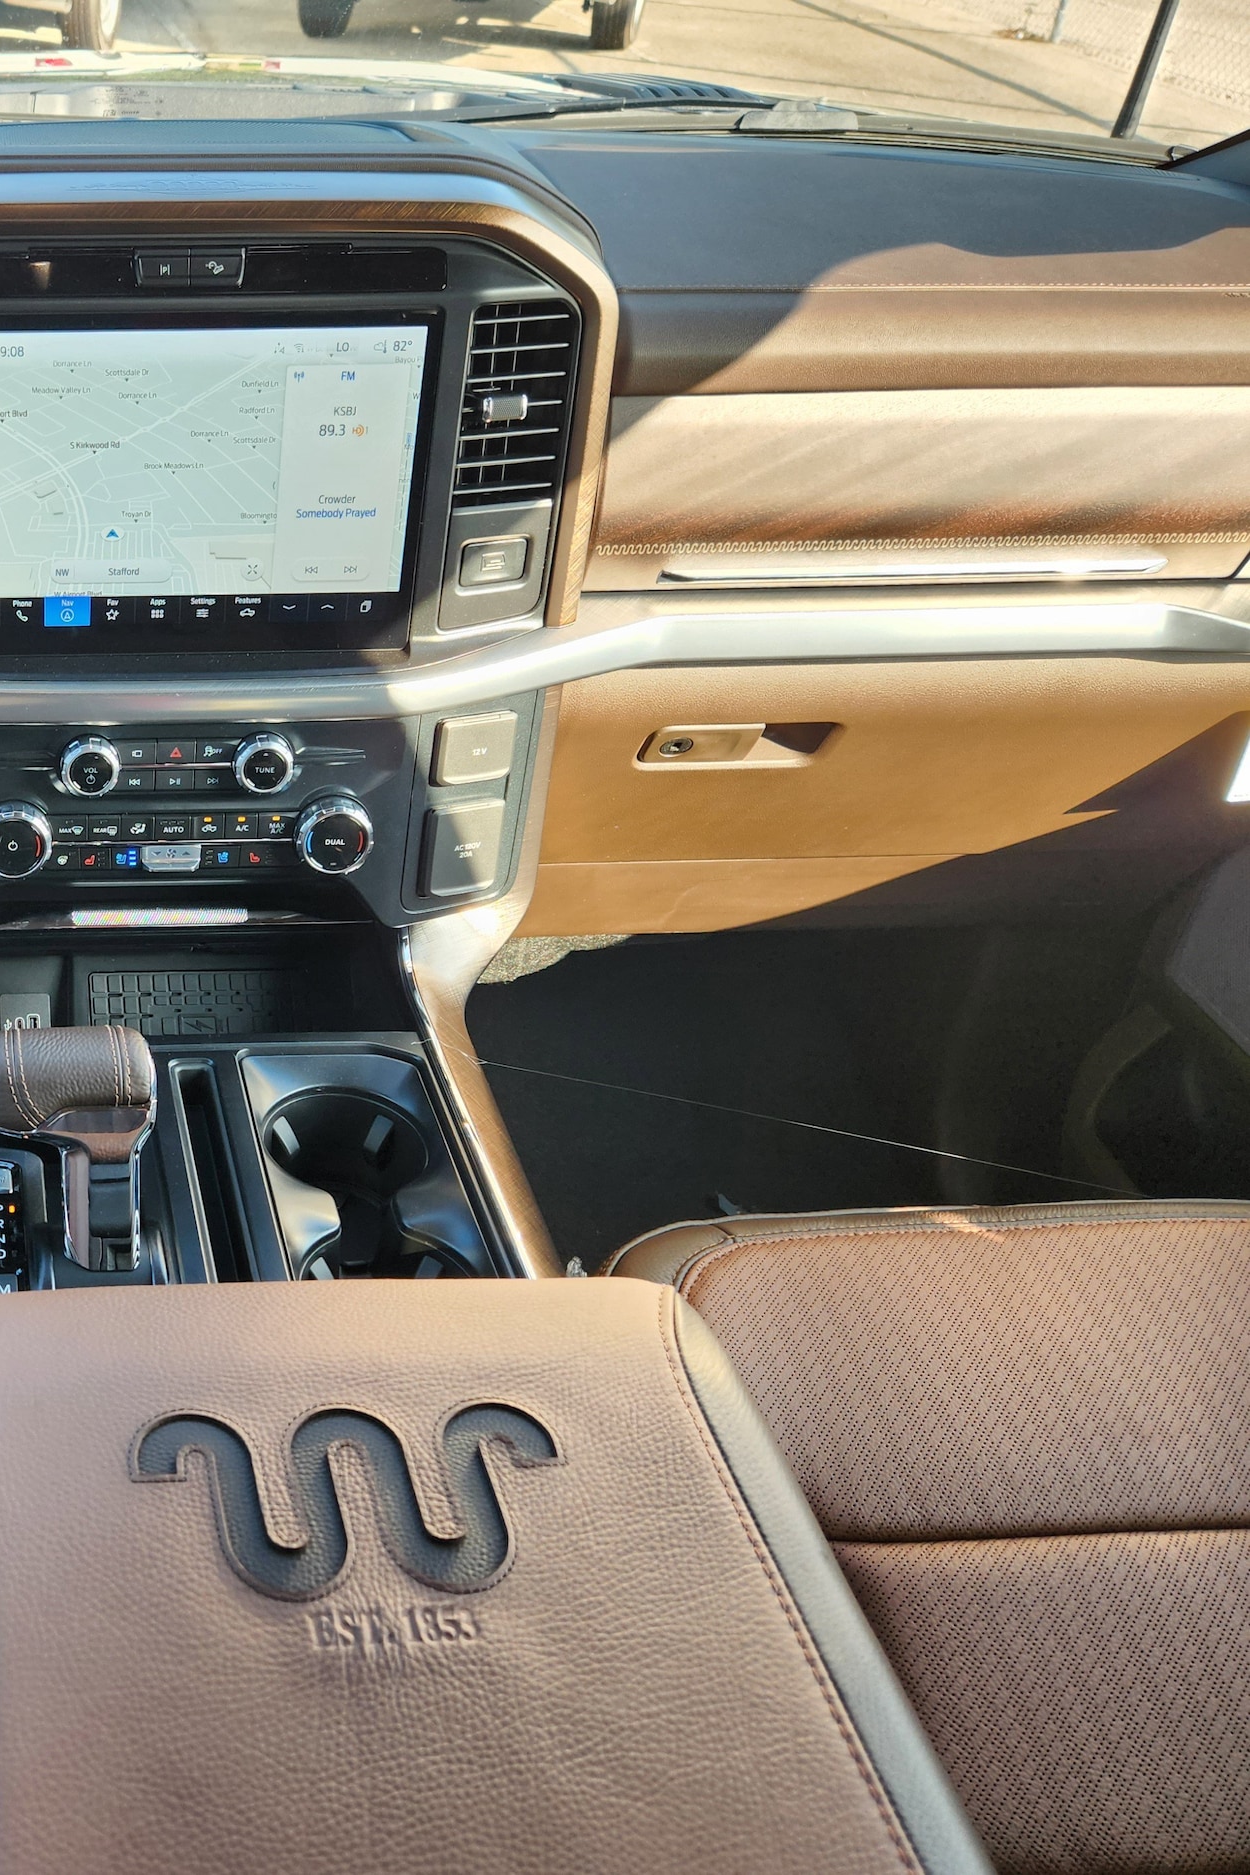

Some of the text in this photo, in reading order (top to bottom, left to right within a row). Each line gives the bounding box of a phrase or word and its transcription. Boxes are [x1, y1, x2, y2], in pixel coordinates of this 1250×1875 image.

[336, 341, 350, 353] LO
[0, 346, 25, 358] 9:08
[52, 359, 92, 368] Dorrance Ln
[105, 368, 149, 377] Scottsdale Dr
[340, 371, 355, 380] FM
[241, 380, 279, 388] Dunfield Ln
[31, 386, 91, 395] Meadow Valley Ln
[118, 391, 157, 399] Dorrance Ln
[12, 409, 28, 418] Blvd
[239, 406, 275, 414] Radford Ln
[333, 406, 357, 416] KSBJ
[190, 429, 229, 437] Dorrance Ln
[318, 424, 346, 436] 89.3
[232, 436, 276, 444] Scottsdale Dr
[70, 441, 120, 449] S Kirkwood Rd
[317, 494, 356, 504] Crowder
[121, 510, 152, 519] Troyan Dr
[295, 507, 376, 520] Somebody Prayed
[55, 567, 140, 577] NW Stafford
[12, 599, 33, 607] Phone
[61, 599, 74, 607] Nav
[106, 598, 120, 606] Fav
[150, 598, 166, 607] Apps
[190, 597, 217, 606] Settings
[234, 596, 262, 605] Features
[83, 766, 98, 774] VOL
[255, 766, 275, 774] TUNE
[162, 826, 184, 834] AUTO
[235, 824, 249, 832] A/C
[324, 838, 346, 846] DUAL
[306, 1605, 481, 1650] EST. 1853
